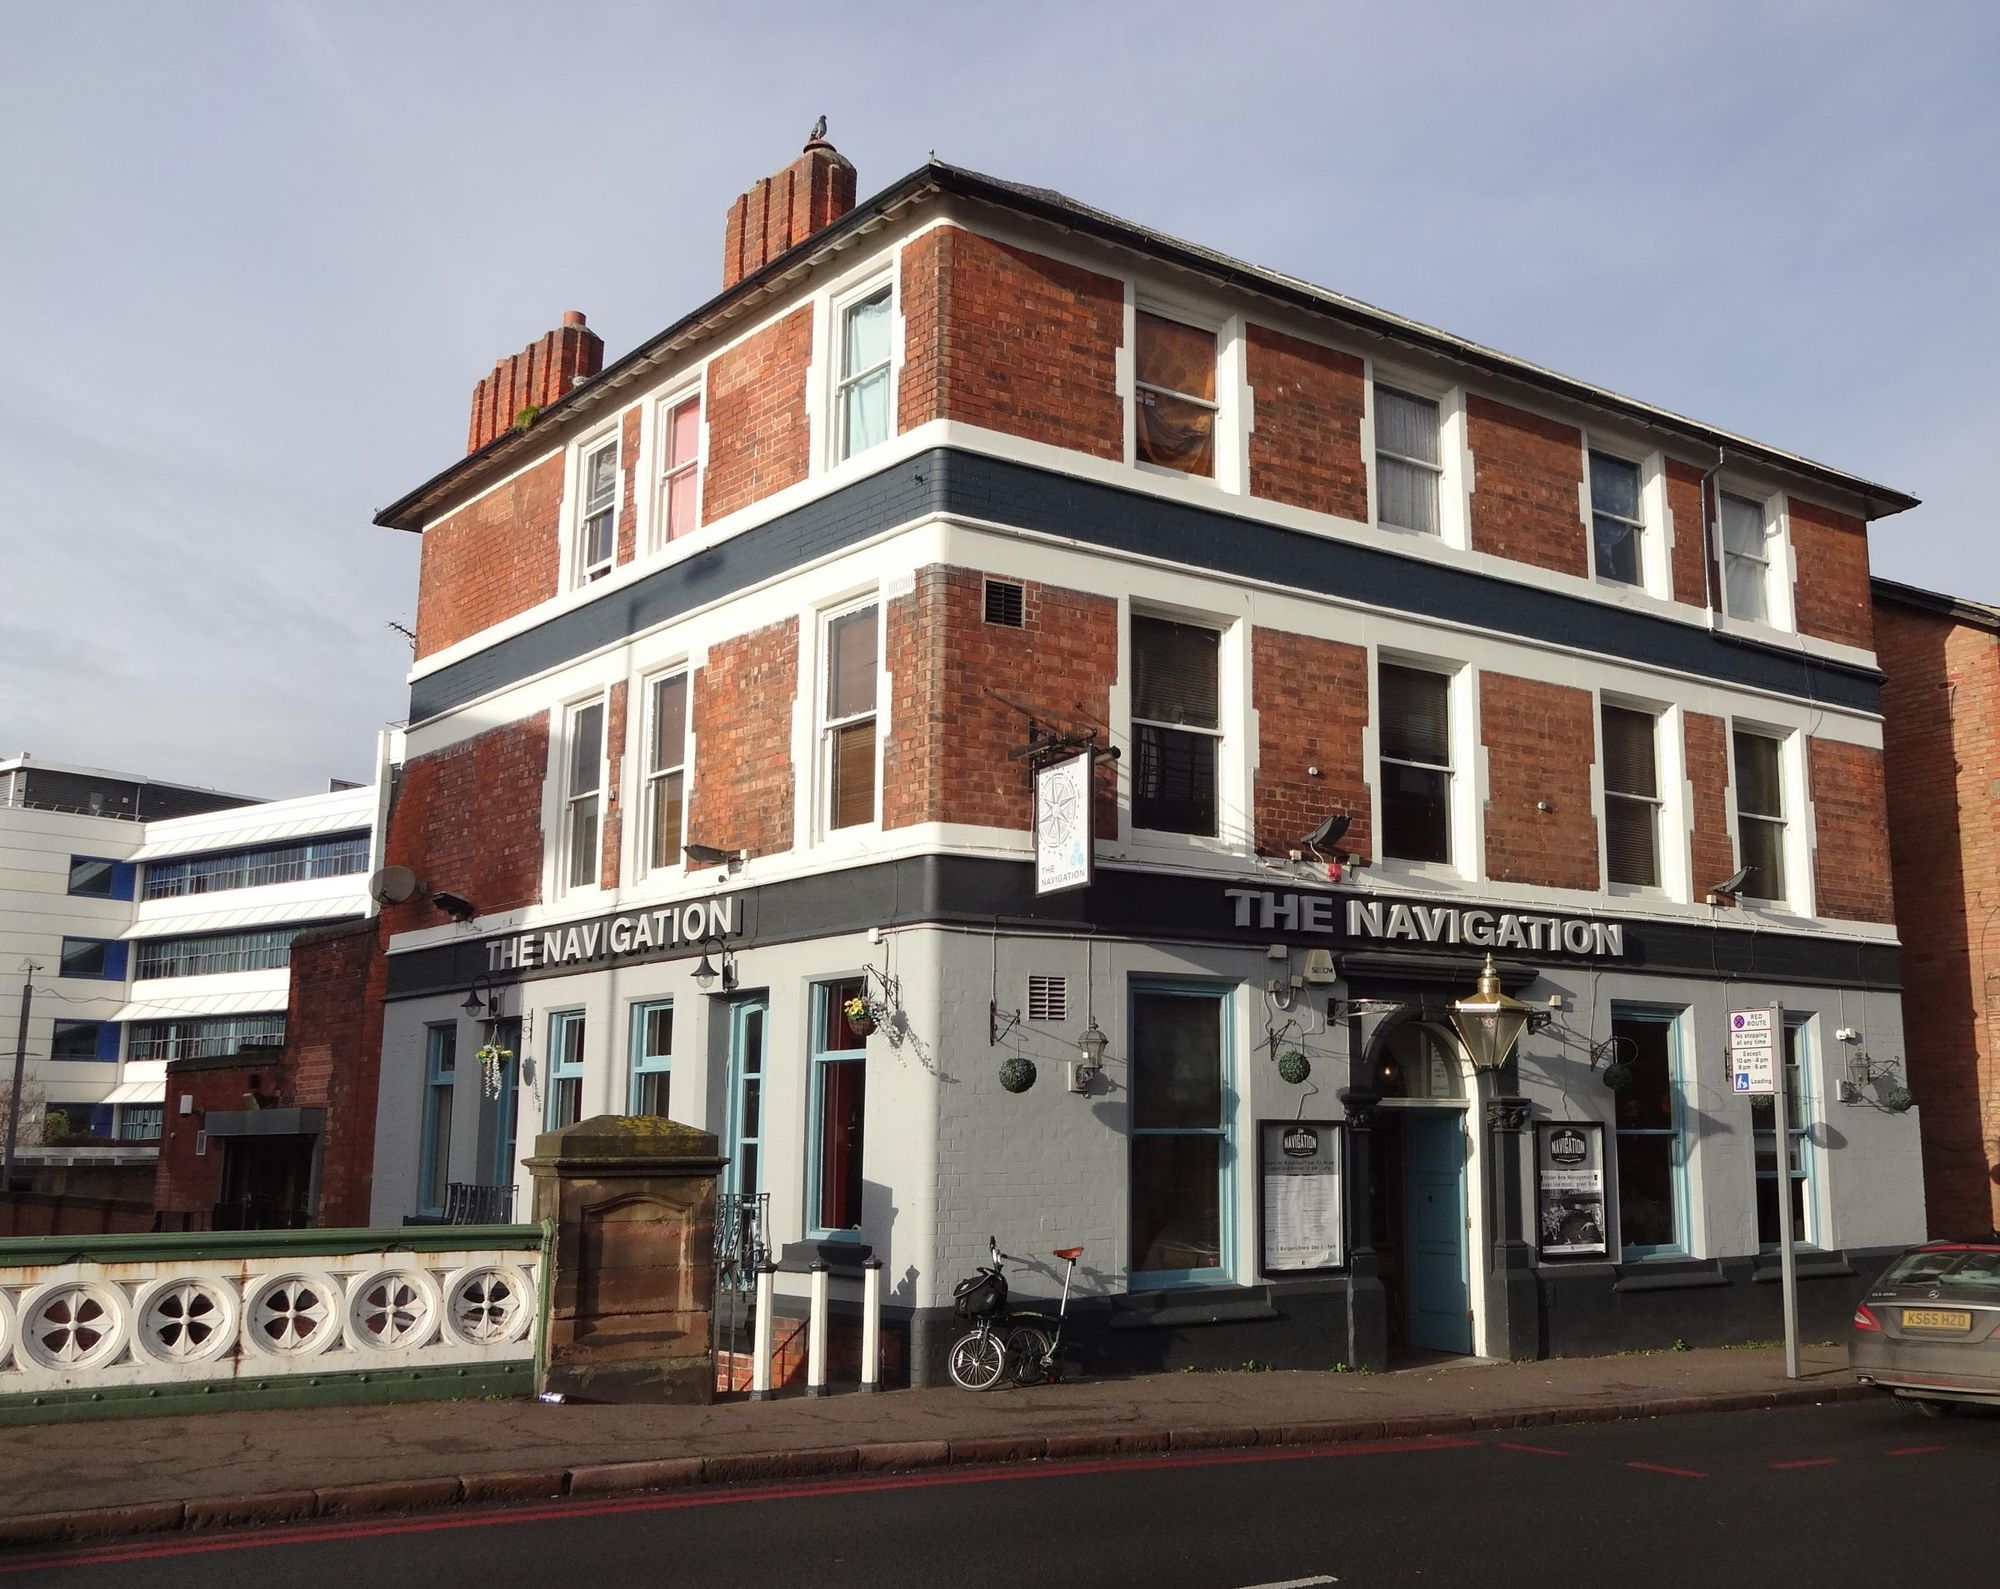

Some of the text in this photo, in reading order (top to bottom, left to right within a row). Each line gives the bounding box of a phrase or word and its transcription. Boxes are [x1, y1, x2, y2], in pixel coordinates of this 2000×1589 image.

[1041, 865, 1055, 875] THE
[1041, 869, 1085, 886] NAVIGATION
[1224, 888, 1623, 956] THE NAVIGATION
[486, 897, 732, 971] THE NAVIGATION
[1744, 1032, 1767, 1040] stopping
[1284, 1134, 1317, 1148] NAVIGATION
[1551, 1137, 1586, 1154] NAVIGATION
[1908, 1312, 1966, 1328] KS65 HZD
